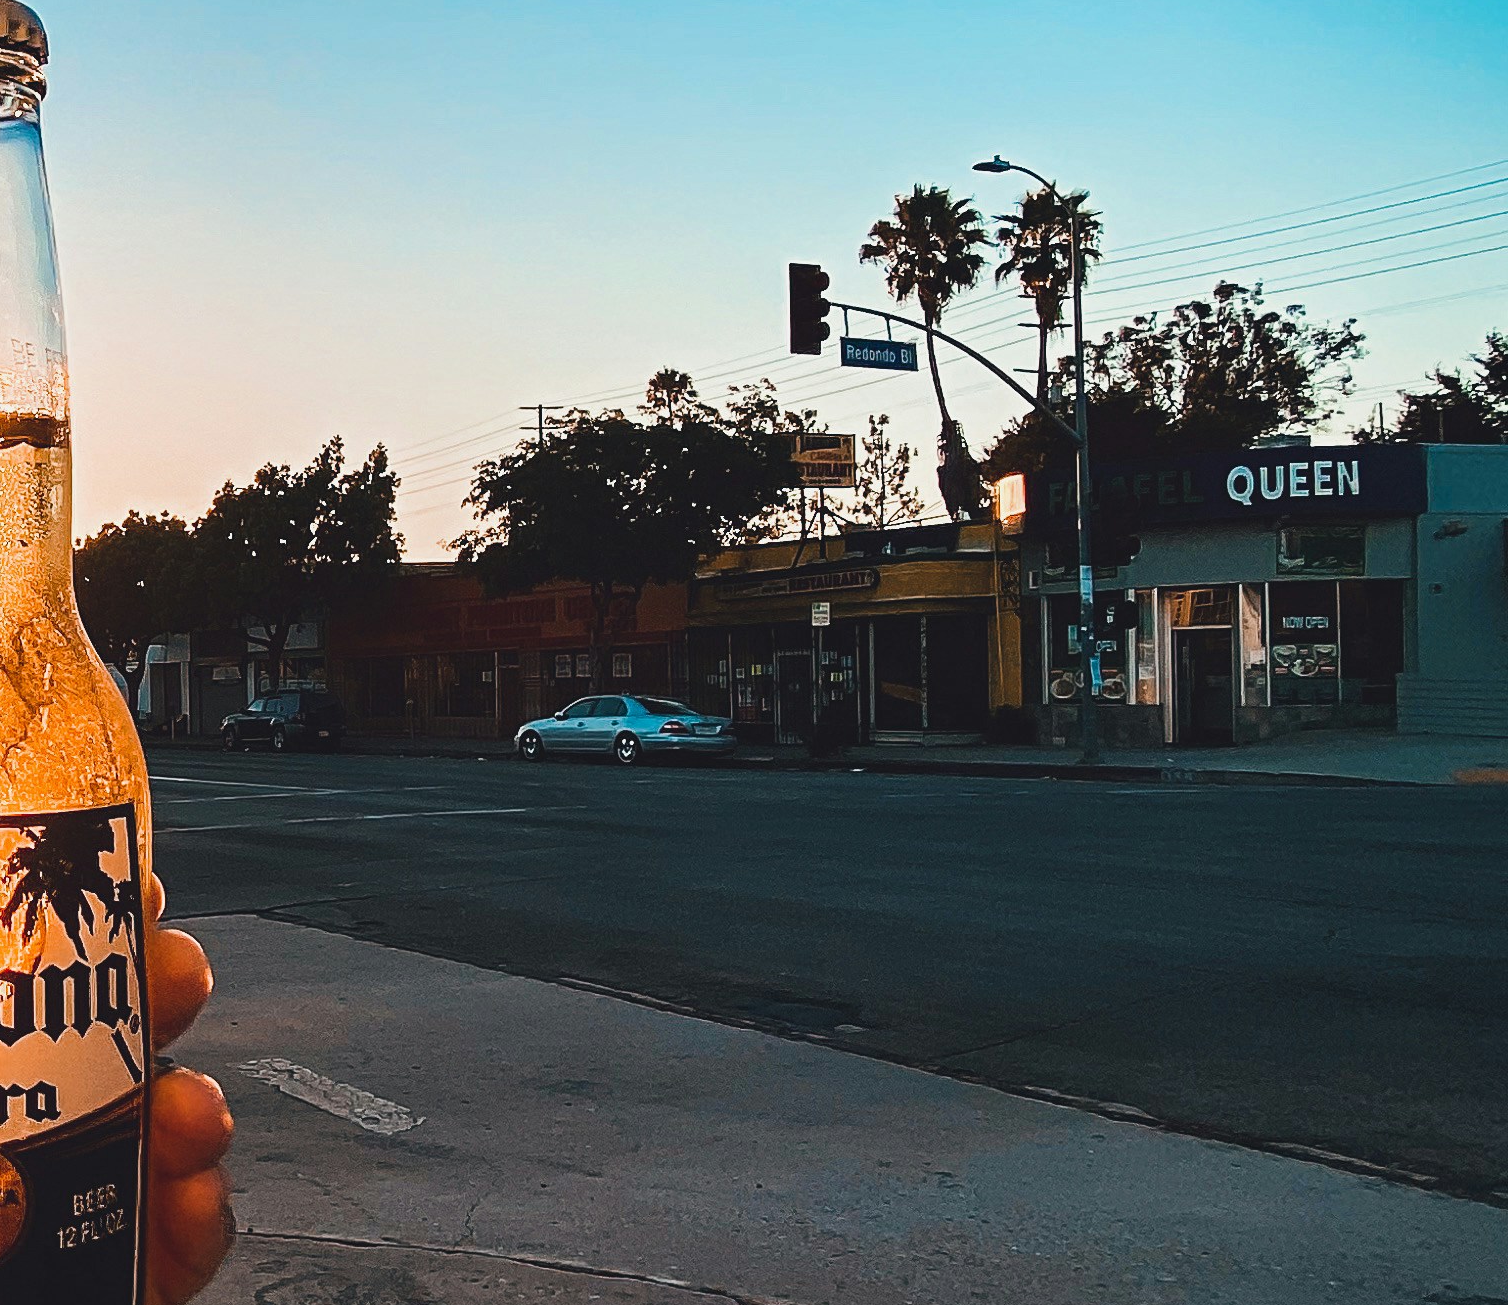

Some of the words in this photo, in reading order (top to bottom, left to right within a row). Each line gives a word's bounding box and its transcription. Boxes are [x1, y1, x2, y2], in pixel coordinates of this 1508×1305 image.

[846, 344, 896, 363] Redondo
[901, 349, 912, 363] Bl
[1226, 460, 1359, 505] QUEEN
[1282, 616, 1304, 629] NOW
[1305, 616, 1329, 629] OPEN
[73, 1184, 117, 1216] BEER
[57, 1226, 77, 1249] 12
